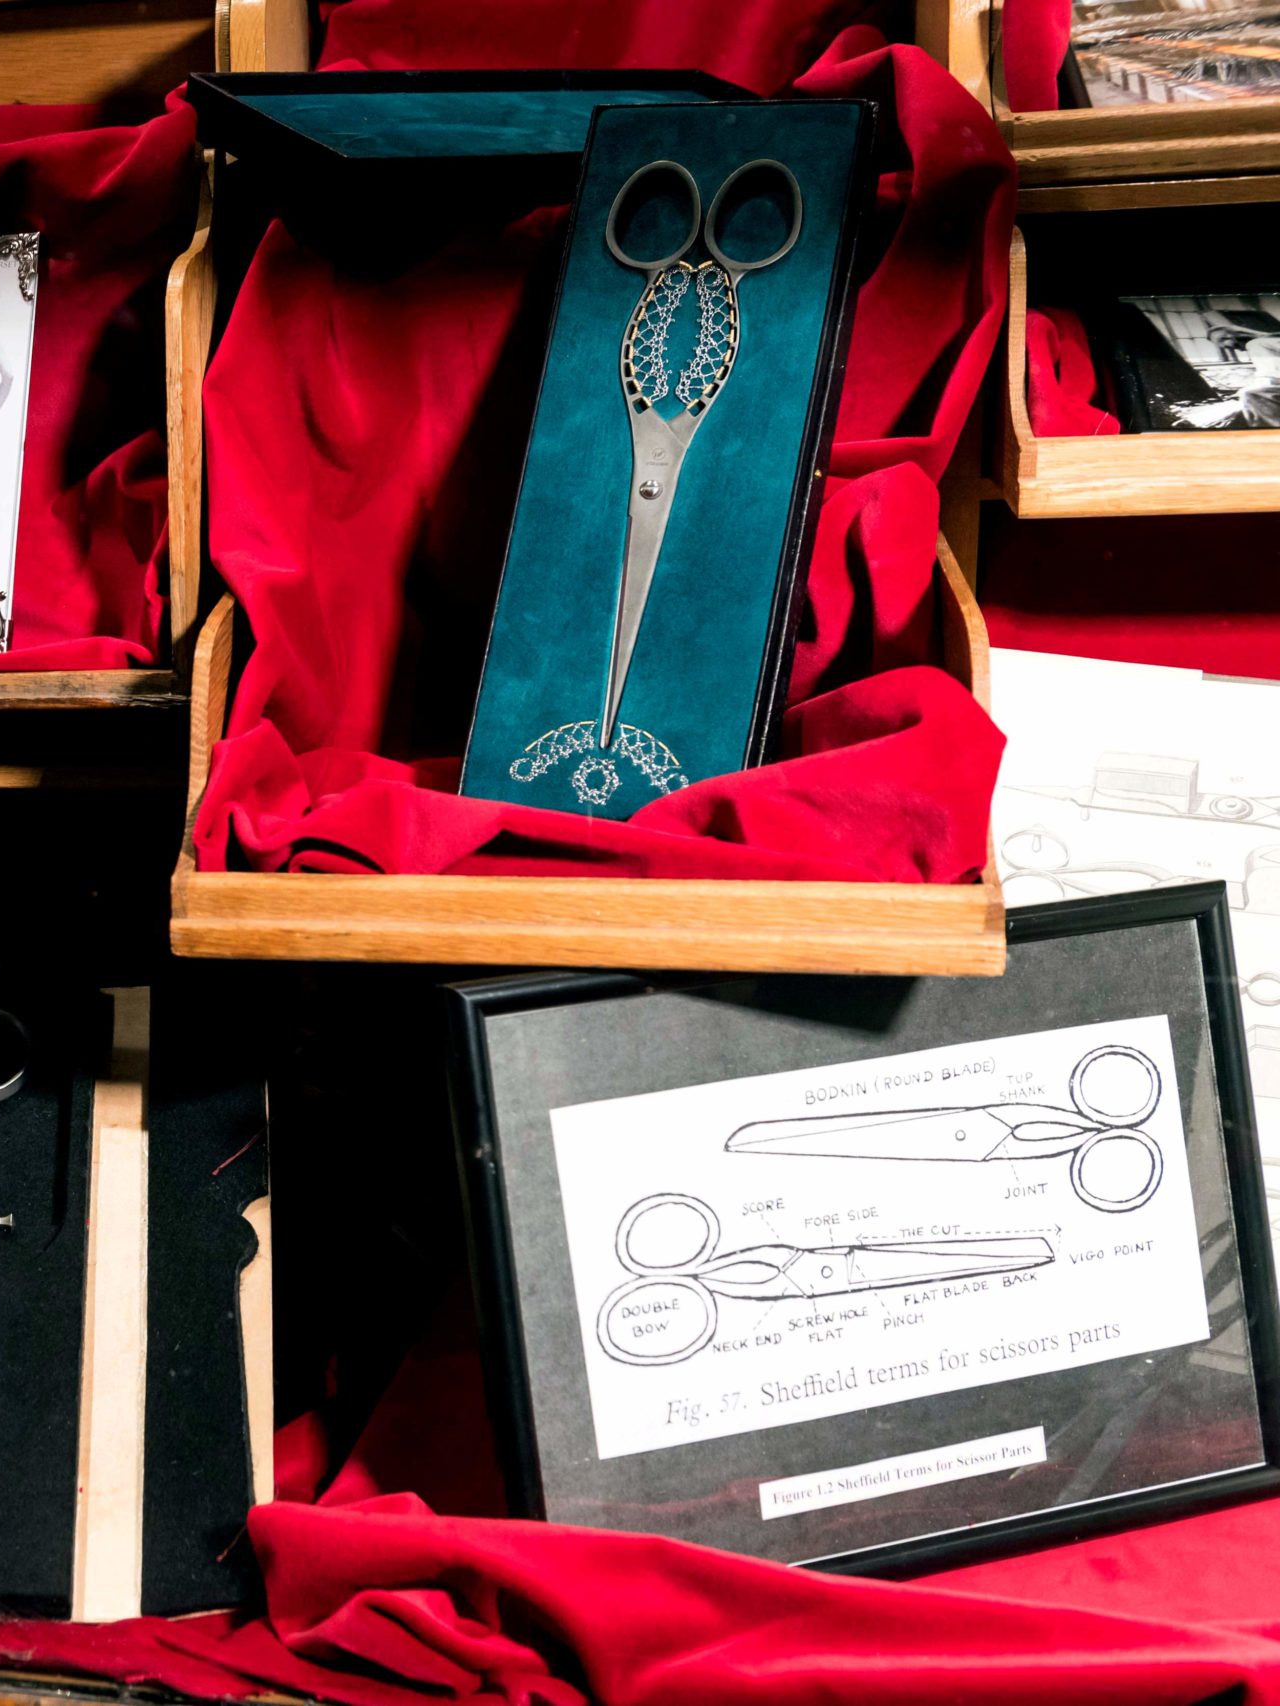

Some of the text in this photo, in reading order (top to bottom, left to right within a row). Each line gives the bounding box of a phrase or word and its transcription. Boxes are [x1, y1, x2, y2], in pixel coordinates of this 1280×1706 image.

[804, 1056, 996, 1106] BODKIN (ROUND BLADE)
[1006, 1071, 1034, 1085] TUP
[999, 1085, 1046, 1103] SHANK
[1004, 1182, 1049, 1200] JOINT
[742, 1198, 786, 1216] SCORE
[804, 1207, 880, 1229] FORE SIDE
[899, 1224, 961, 1238] THE CUT
[1069, 1240, 1154, 1265] VIGO POINT
[903, 1272, 1037, 1307] FLAT BLADE BACK
[620, 1298, 681, 1319] DOUBLE
[787, 1306, 869, 1332] SCREW HOLE
[632, 1319, 670, 1338] BOW
[882, 1313, 924, 1330] PINCH
[713, 1332, 782, 1354] NECK END
[808, 1327, 844, 1344] FLAT
[664, 1397, 710, 1427] Fig.
[760, 1366, 859, 1406] Sheffield
[868, 1359, 930, 1385] terms
[938, 1348, 969, 1372] for
[979, 1333, 1059, 1365] scissors
[1068, 1322, 1121, 1353] parts
[772, 1443, 1033, 1505] Figure 1.2 Sheffield Terms for Scissor Parts
